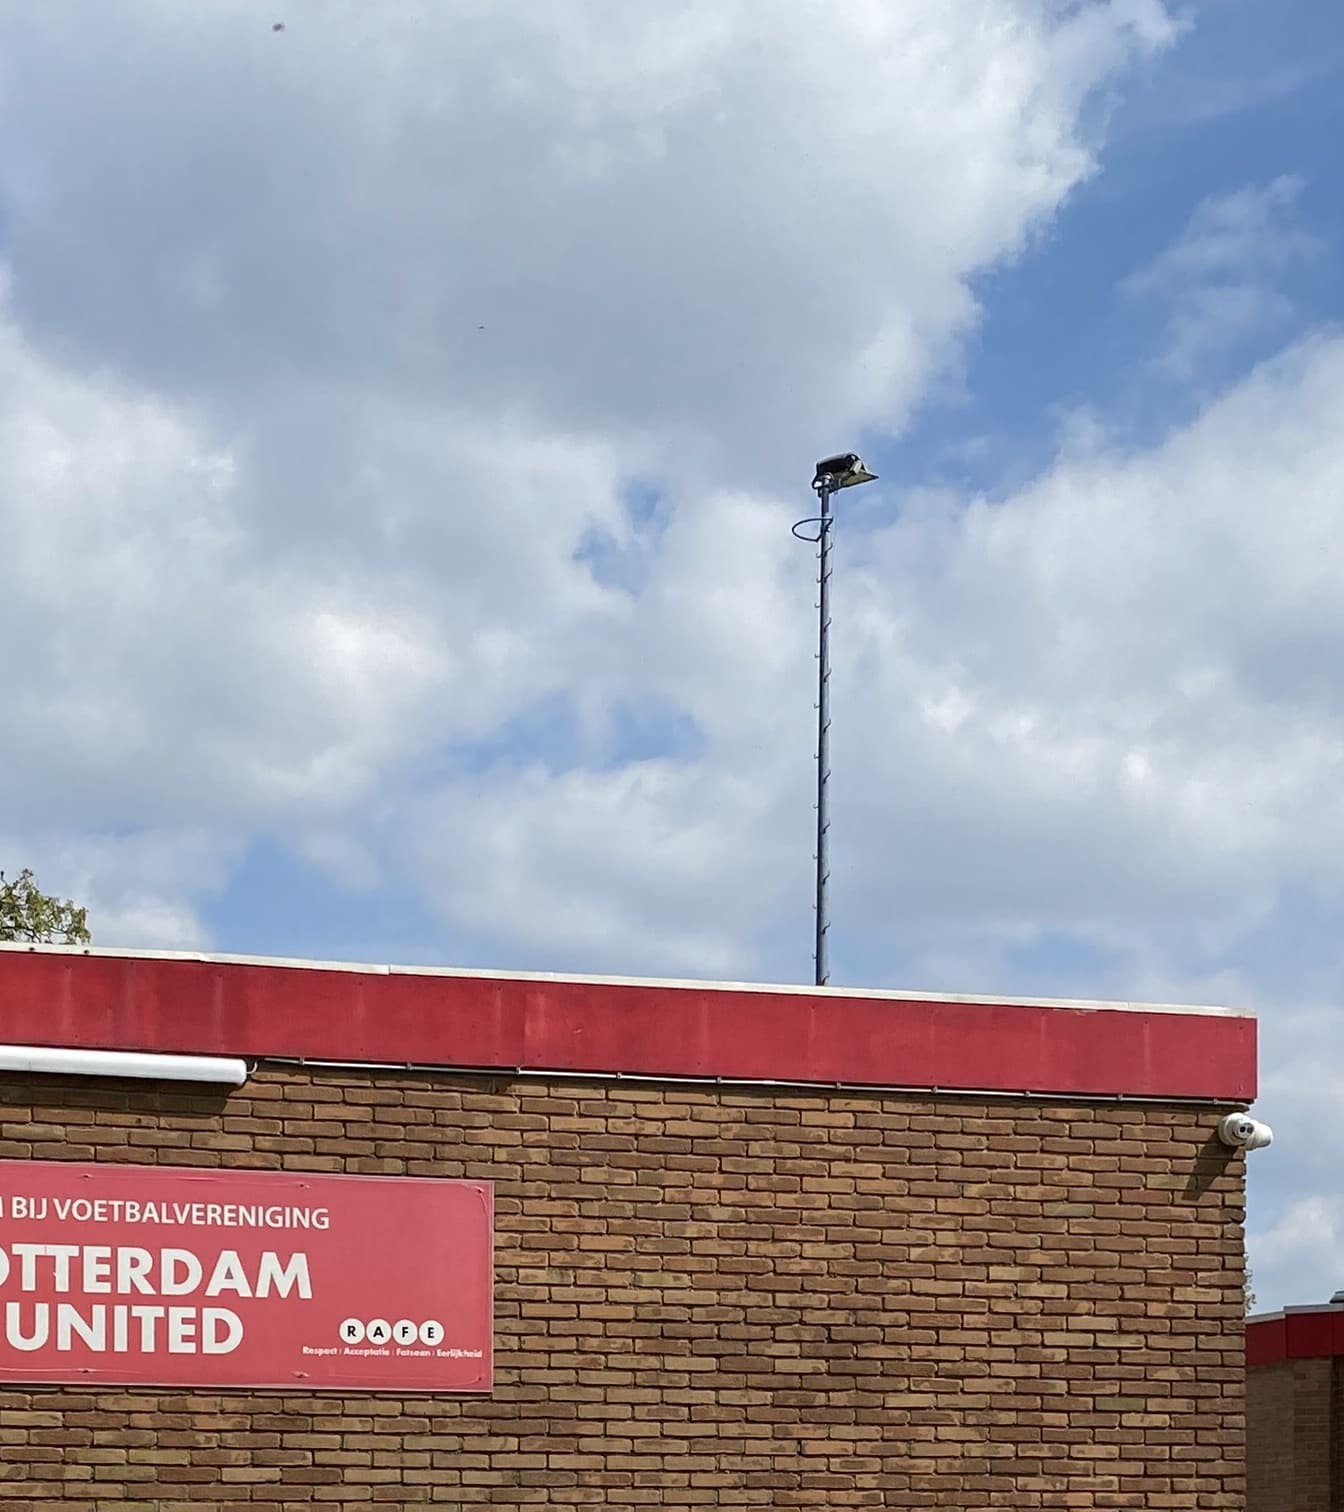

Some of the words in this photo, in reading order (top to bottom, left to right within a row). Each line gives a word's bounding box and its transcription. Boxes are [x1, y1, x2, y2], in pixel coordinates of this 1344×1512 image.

[11, 1196, 48, 1220] BIJ
[53, 1197, 330, 1230] VOETBALVERENIGING
[5, 1301, 244, 1355] UNITED
[302, 1346, 337, 1356] Respect
[343, 1346, 390, 1357] Acceptatie
[436, 1348, 483, 1358] Eerlijkheid
